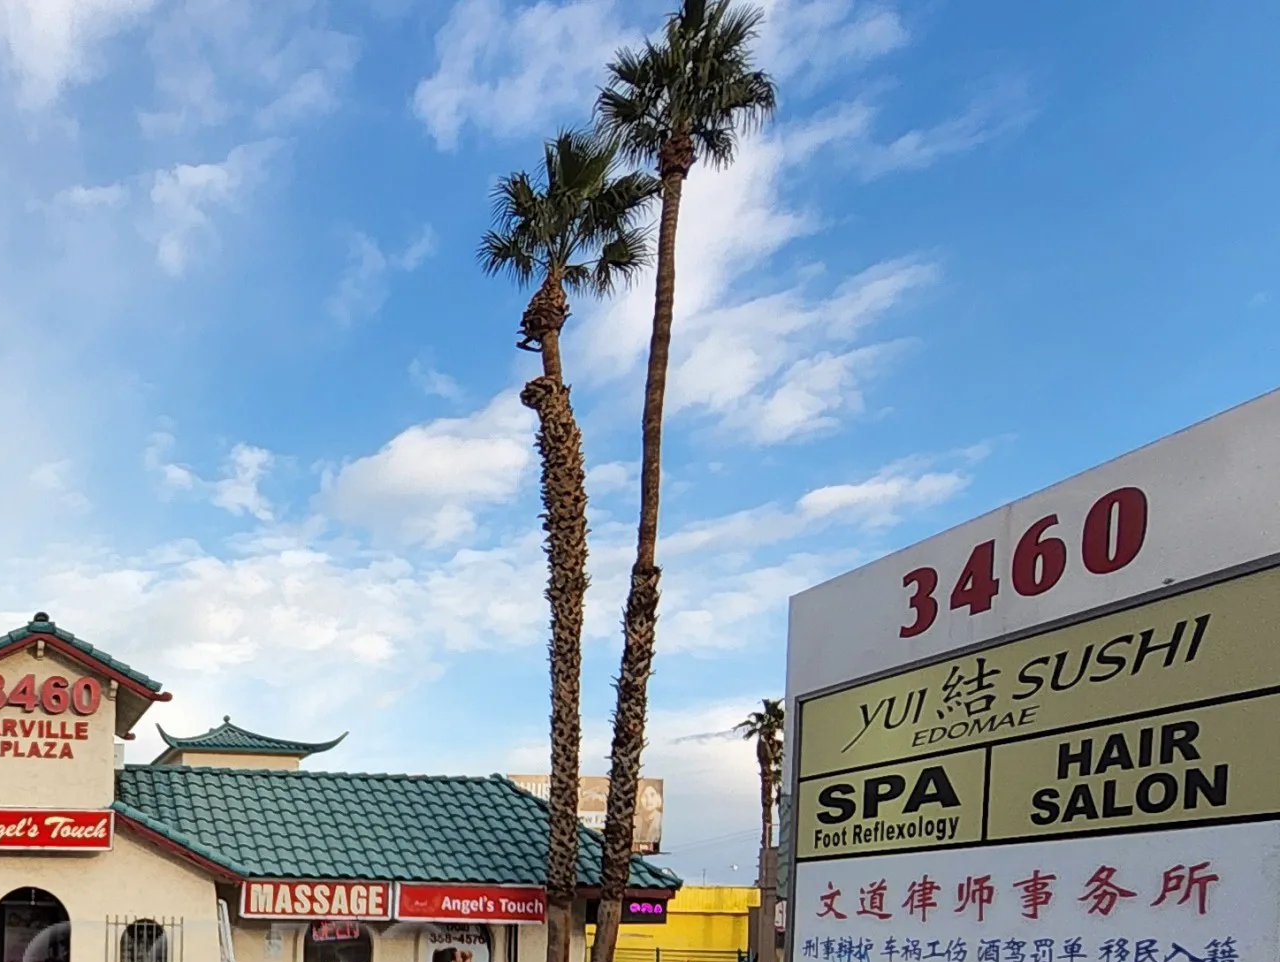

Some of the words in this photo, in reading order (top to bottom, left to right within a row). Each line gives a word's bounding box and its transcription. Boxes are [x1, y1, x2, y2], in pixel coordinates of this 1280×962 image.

[899, 487, 1148, 638] 3460
[935, 657, 1002, 720] 結
[1012, 613, 1211, 701] SUSHI
[911, 705, 1040, 748] EDOMAE
[0, 741, 74, 760] PLAZA
[1056, 720, 1202, 780] HAIR
[816, 765, 961, 825] SPA
[1030, 764, 1229, 826] SALON
[44, 816, 108, 839] Touch
[814, 828, 848, 849] Foot
[852, 815, 960, 845] Reflexology
[250, 883, 384, 915] MASSAGE
[441, 895, 494, 914] Angel's
[499, 898, 544, 914] Touch
[816, 861, 1220, 924] 文道律师事务所
[880, 936, 968, 962] 车祸工伤
